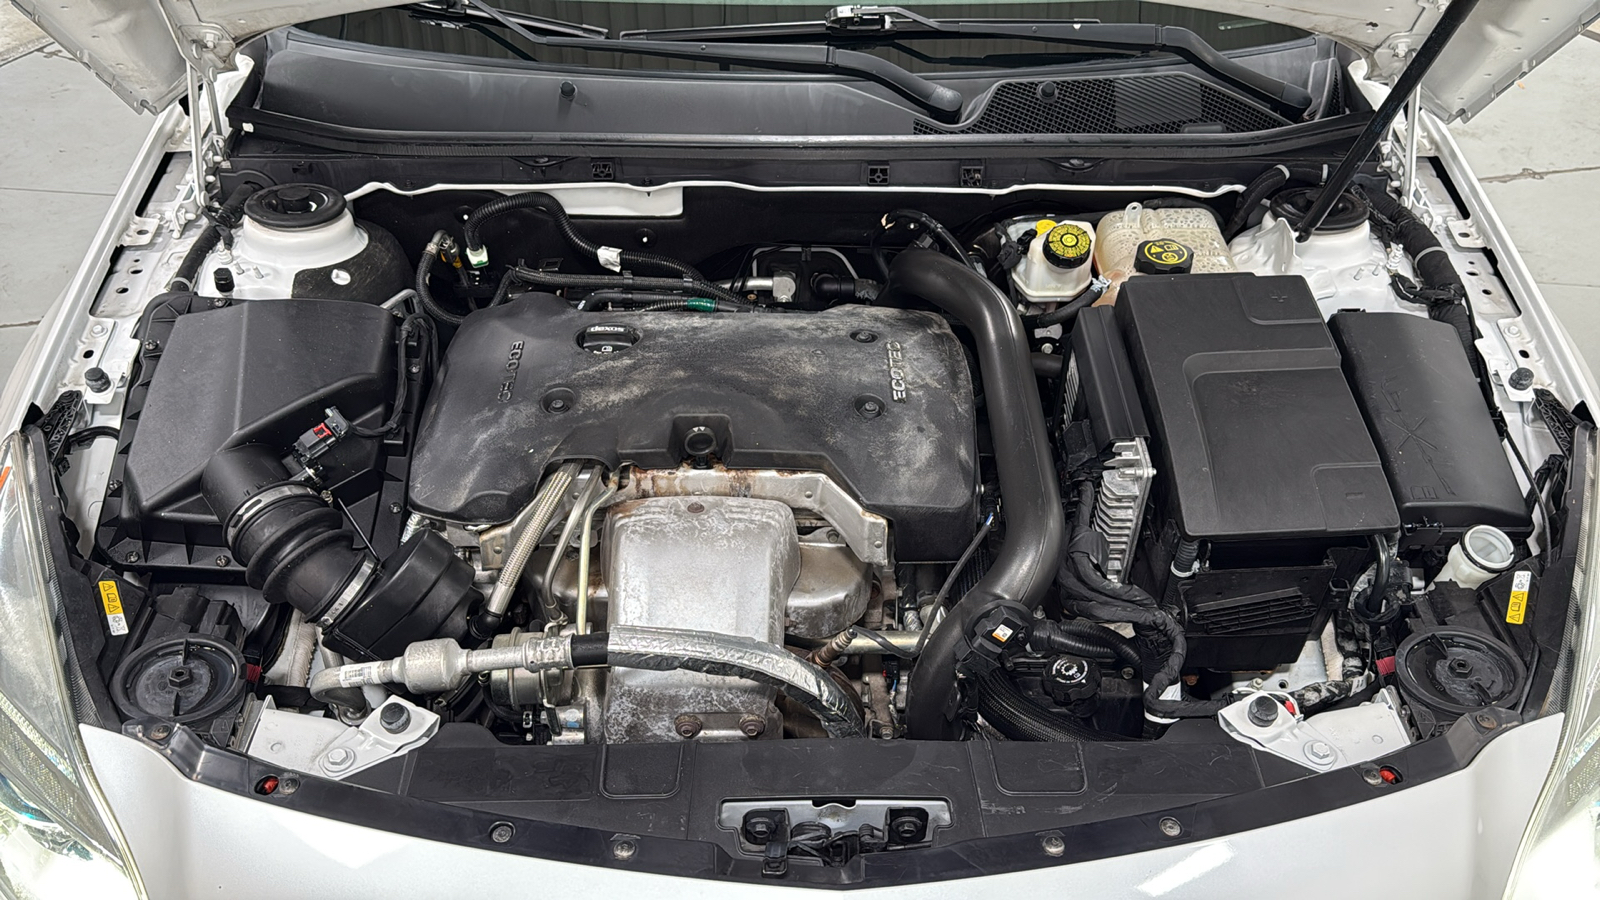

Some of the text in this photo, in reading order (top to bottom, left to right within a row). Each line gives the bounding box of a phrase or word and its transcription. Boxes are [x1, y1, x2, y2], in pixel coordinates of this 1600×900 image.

[590, 325, 625, 333] dexos
[498, 340, 525, 403] ECOTEC
[886, 341, 906, 402] ECOTEC
